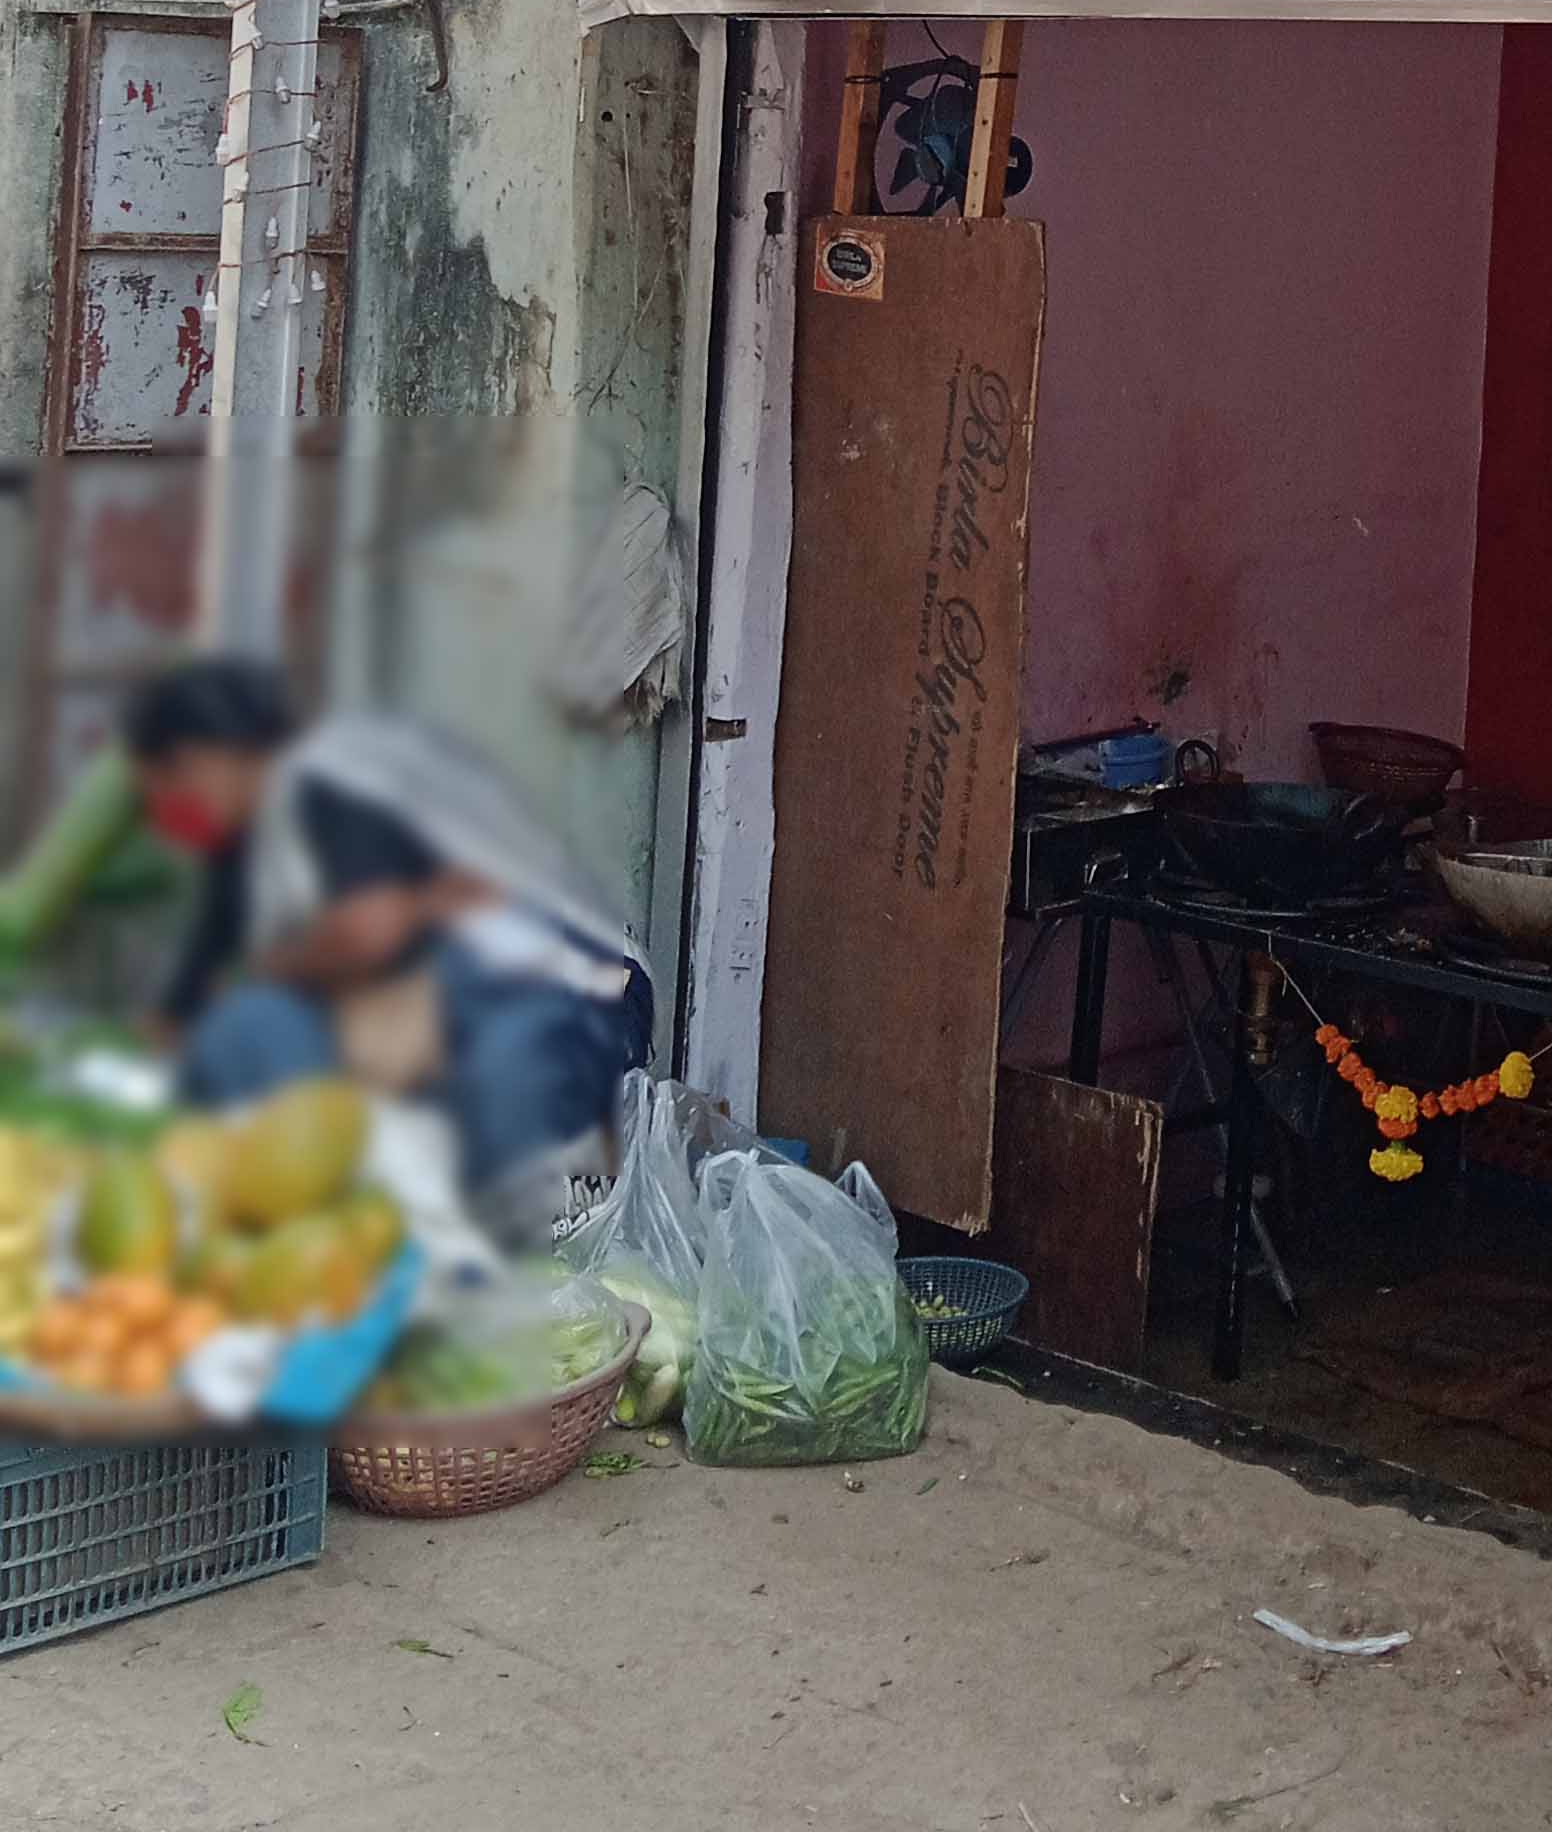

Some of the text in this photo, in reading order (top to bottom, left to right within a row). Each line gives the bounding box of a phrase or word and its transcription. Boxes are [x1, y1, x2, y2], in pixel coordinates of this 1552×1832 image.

[952, 365, 1014, 569] Birla
[918, 571, 940, 657] Board
[915, 597, 986, 889] Supreme
[894, 812, 911, 879] Door
